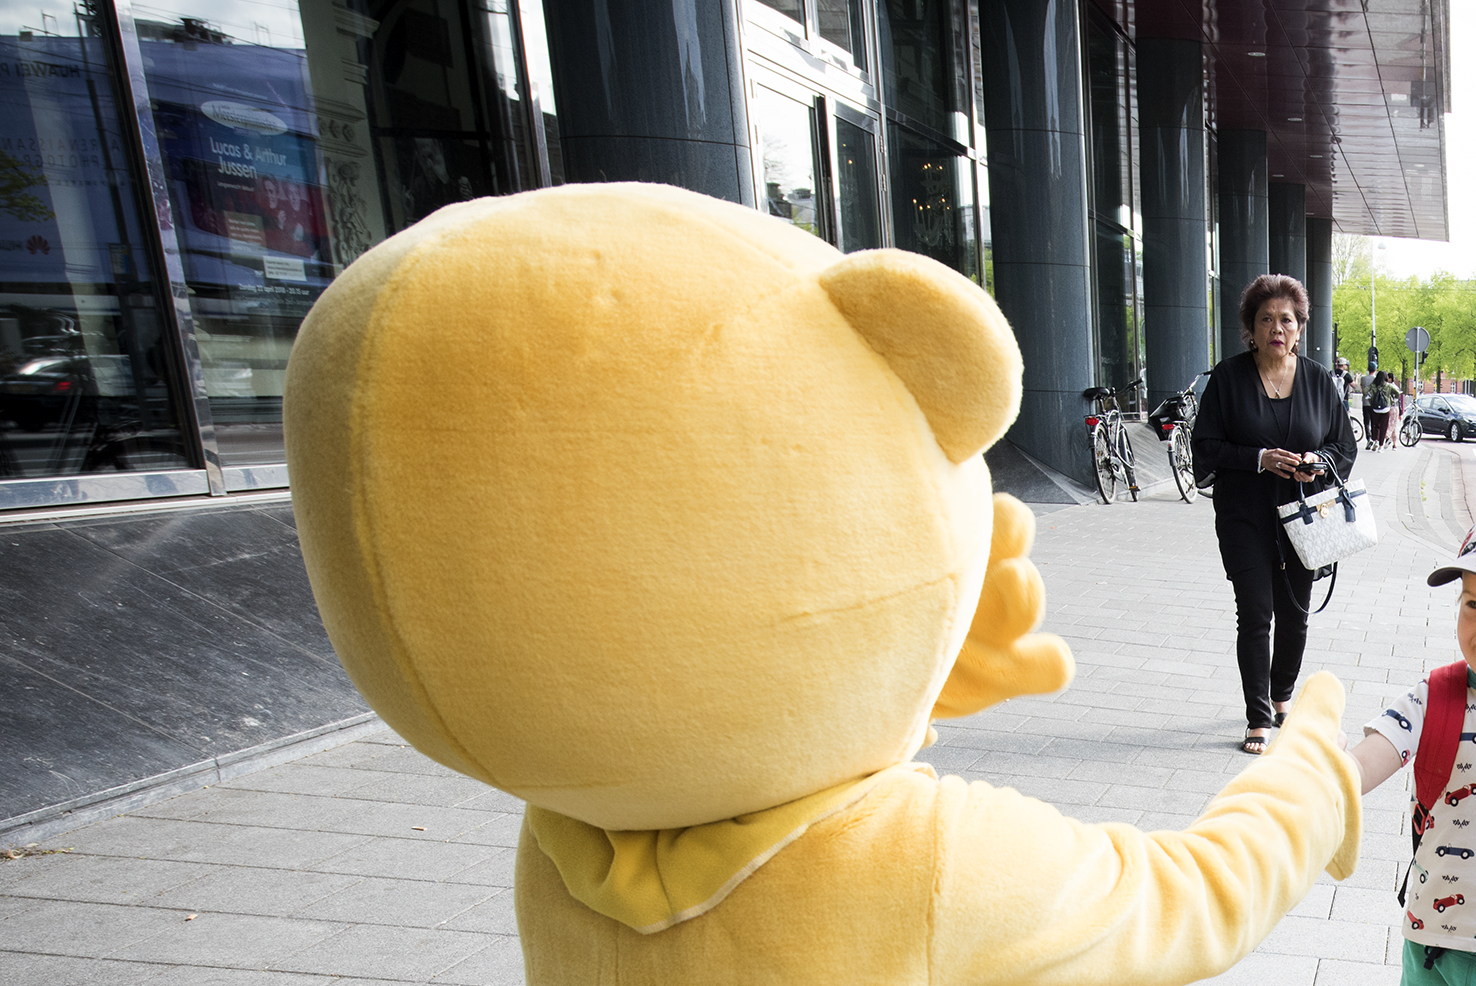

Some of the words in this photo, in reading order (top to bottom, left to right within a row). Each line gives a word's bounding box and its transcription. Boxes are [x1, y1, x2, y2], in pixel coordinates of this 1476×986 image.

[209, 136, 241, 159] Lucas
[243, 143, 254, 161] &
[255, 146, 287, 167] Arthur
[217, 155, 258, 180] Jussen
